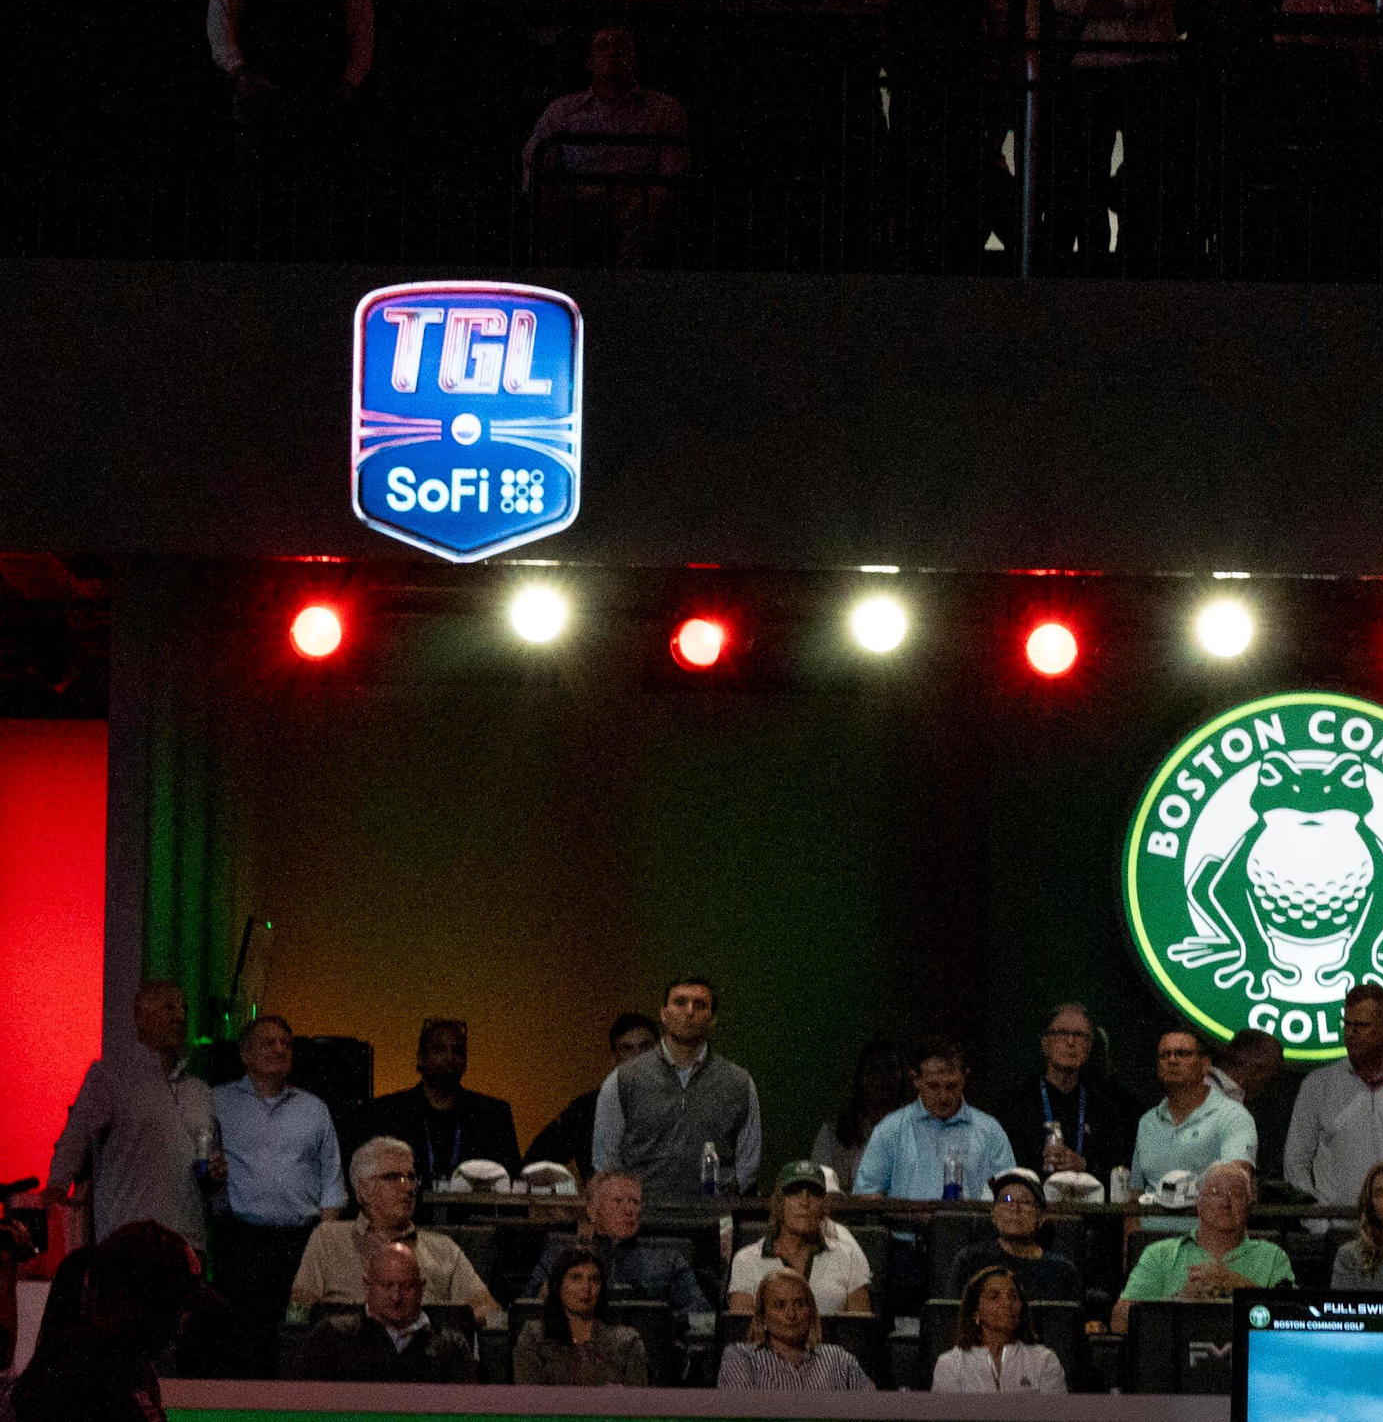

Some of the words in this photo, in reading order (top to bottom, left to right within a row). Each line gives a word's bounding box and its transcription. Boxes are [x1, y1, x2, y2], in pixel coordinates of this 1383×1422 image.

[383, 307, 552, 395] TGL
[386, 466, 490, 513] SoFi
[1146, 713, 1287, 859] BOSTON
[1247, 1002, 1345, 1044] GOL
[1273, 1320, 1306, 1330] BOSTON
[1307, 1320, 1343, 1330] COMMON
[1344, 1321, 1365, 1331] GOLF
[1323, 1302, 1357, 1315] FULL
